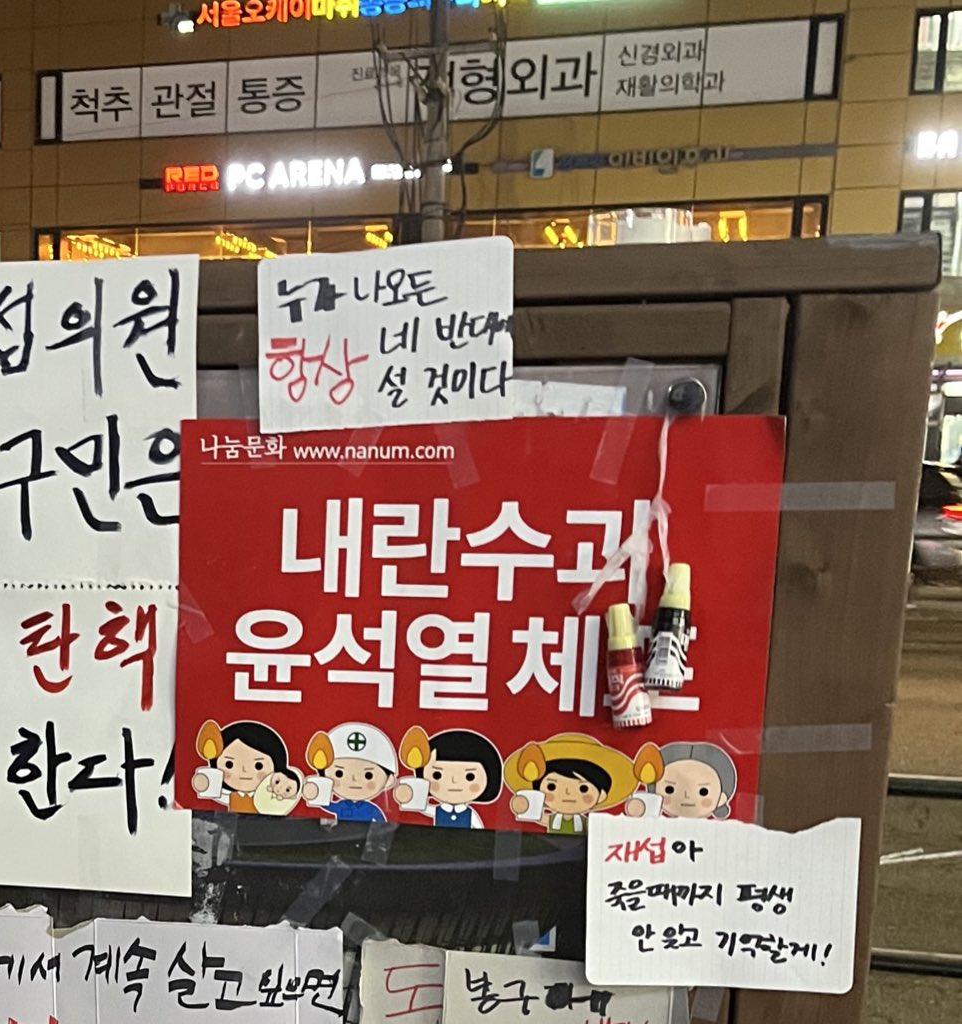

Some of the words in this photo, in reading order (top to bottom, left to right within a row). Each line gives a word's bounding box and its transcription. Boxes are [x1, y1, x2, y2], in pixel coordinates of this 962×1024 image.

[618, 39, 705, 66] 신경외과
[69, 85, 133, 123] 척추
[150, 79, 217, 120] 관절
[237, 75, 306, 115] 통증
[615, 70, 725, 99] 재활의학과
[164, 164, 220, 184] RED
[227, 161, 267, 192] PC
[268, 156, 366, 189] ARENA
[354, 267, 449, 308] 나오든
[265, 334, 369, 406] 항상
[380, 316, 420, 355] 네
[378, 365, 408, 408] 설
[425, 360, 513, 407] 것이다
[200, 434, 288, 461] 나눔문화
[293, 443, 456, 461] www.nanum.com
[280, 497, 653, 605] 내란수괴
[19, 600, 158, 712] 탄핵
[225, 608, 492, 713] 윤석열
[604, 837, 704, 865] 재섭아
[736, 883, 794, 916] 평생
[631, 923, 656, 953] 안
[71, 936, 158, 1013] 계속
[167, 940, 258, 1011] 살고
